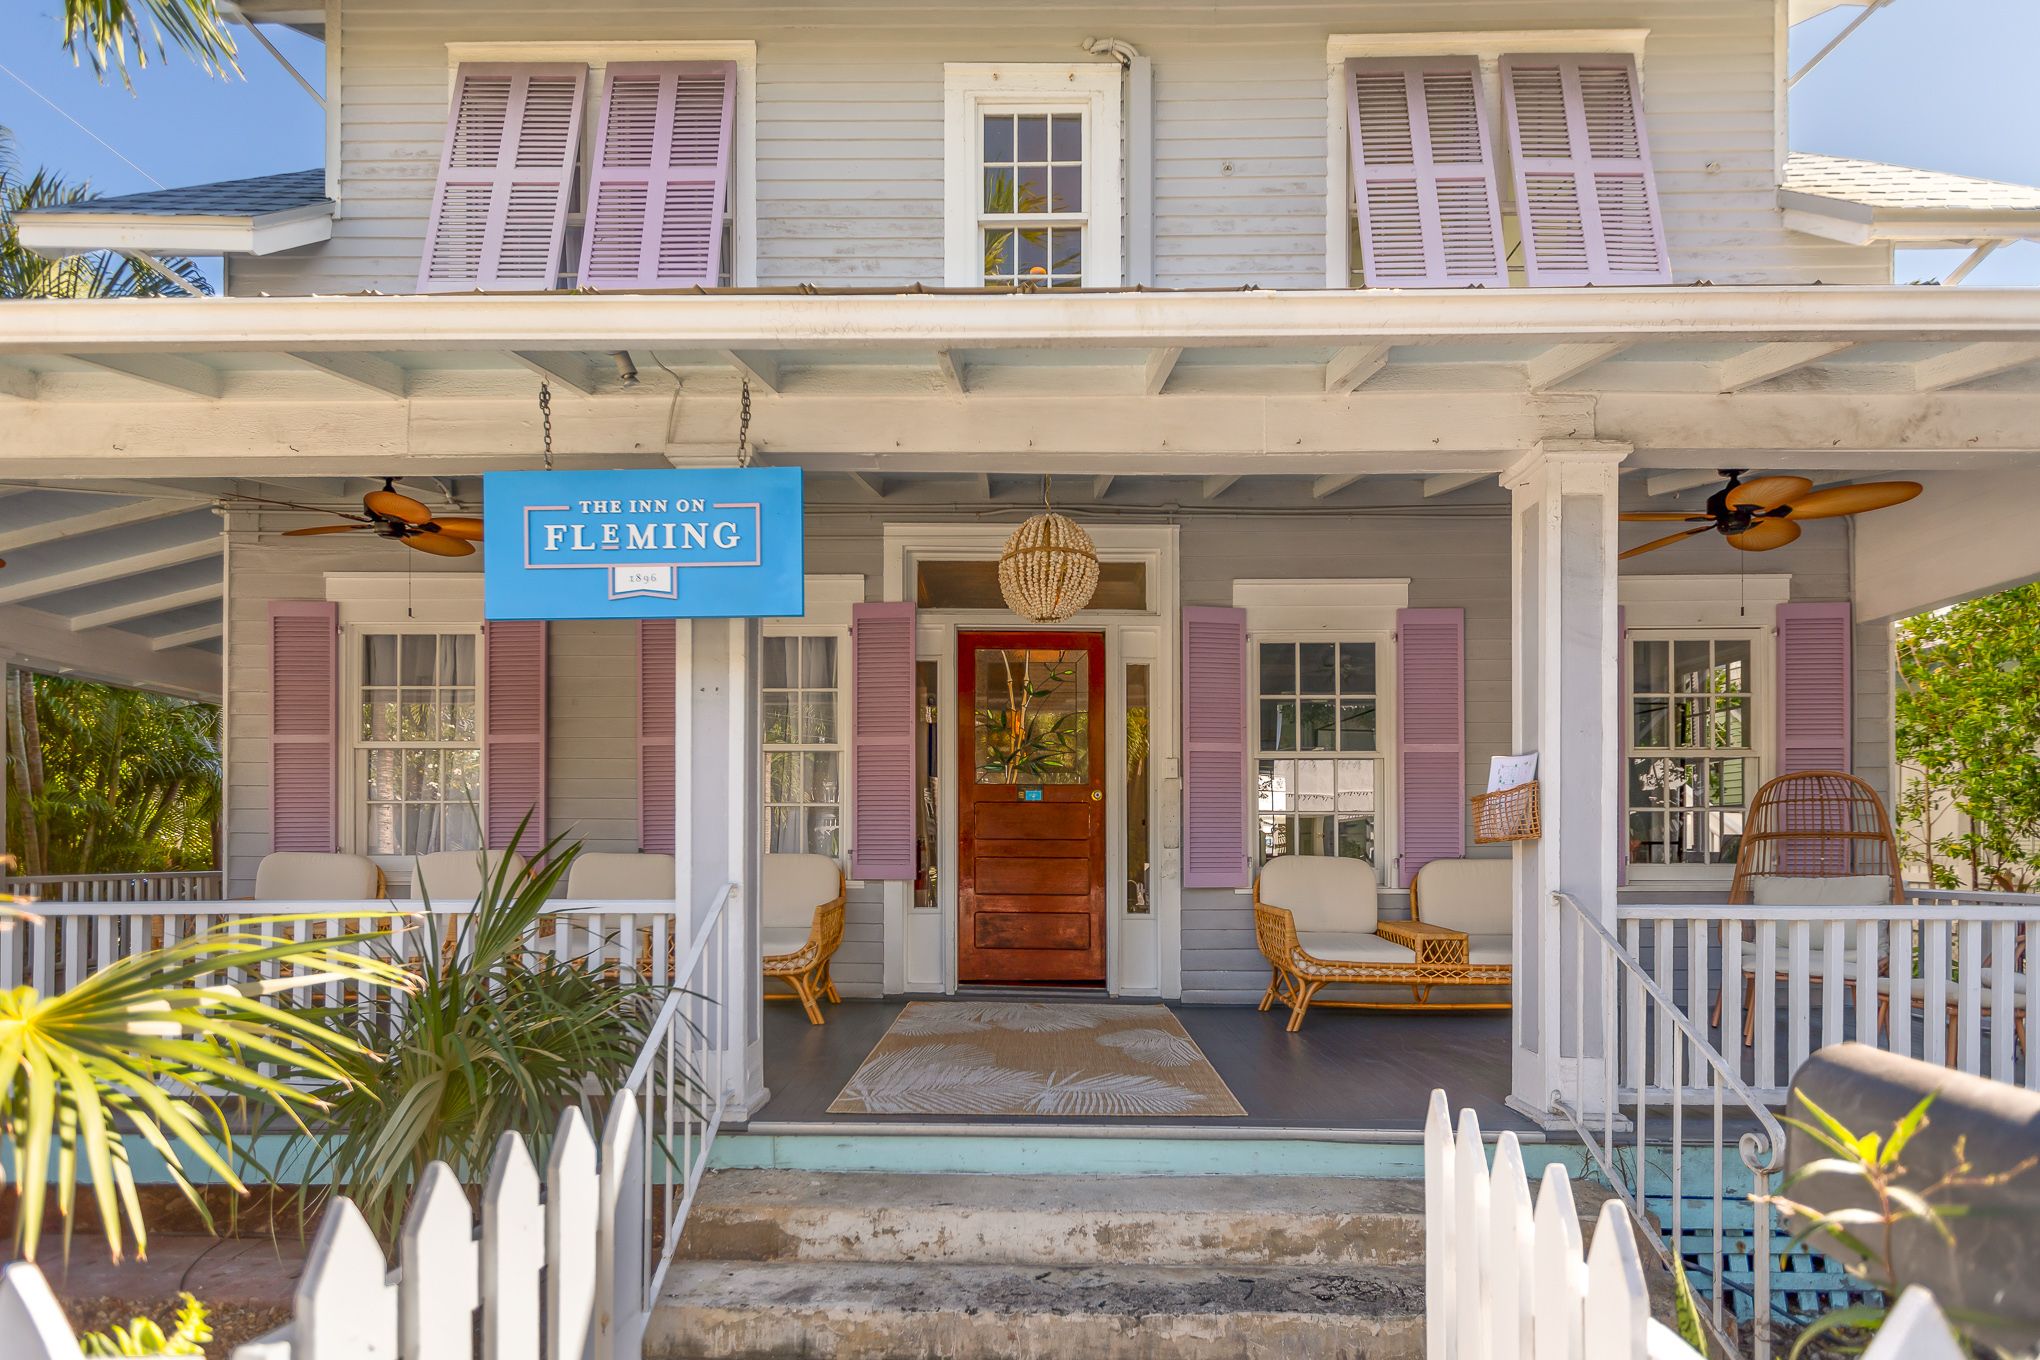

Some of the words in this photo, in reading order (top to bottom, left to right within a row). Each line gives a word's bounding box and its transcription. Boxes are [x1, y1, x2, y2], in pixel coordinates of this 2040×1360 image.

[579, 500, 622, 514] THE
[629, 499, 668, 513] INN
[675, 498, 706, 513] ON
[543, 521, 741, 551] FLEMING
[629, 573, 657, 584] 1896
